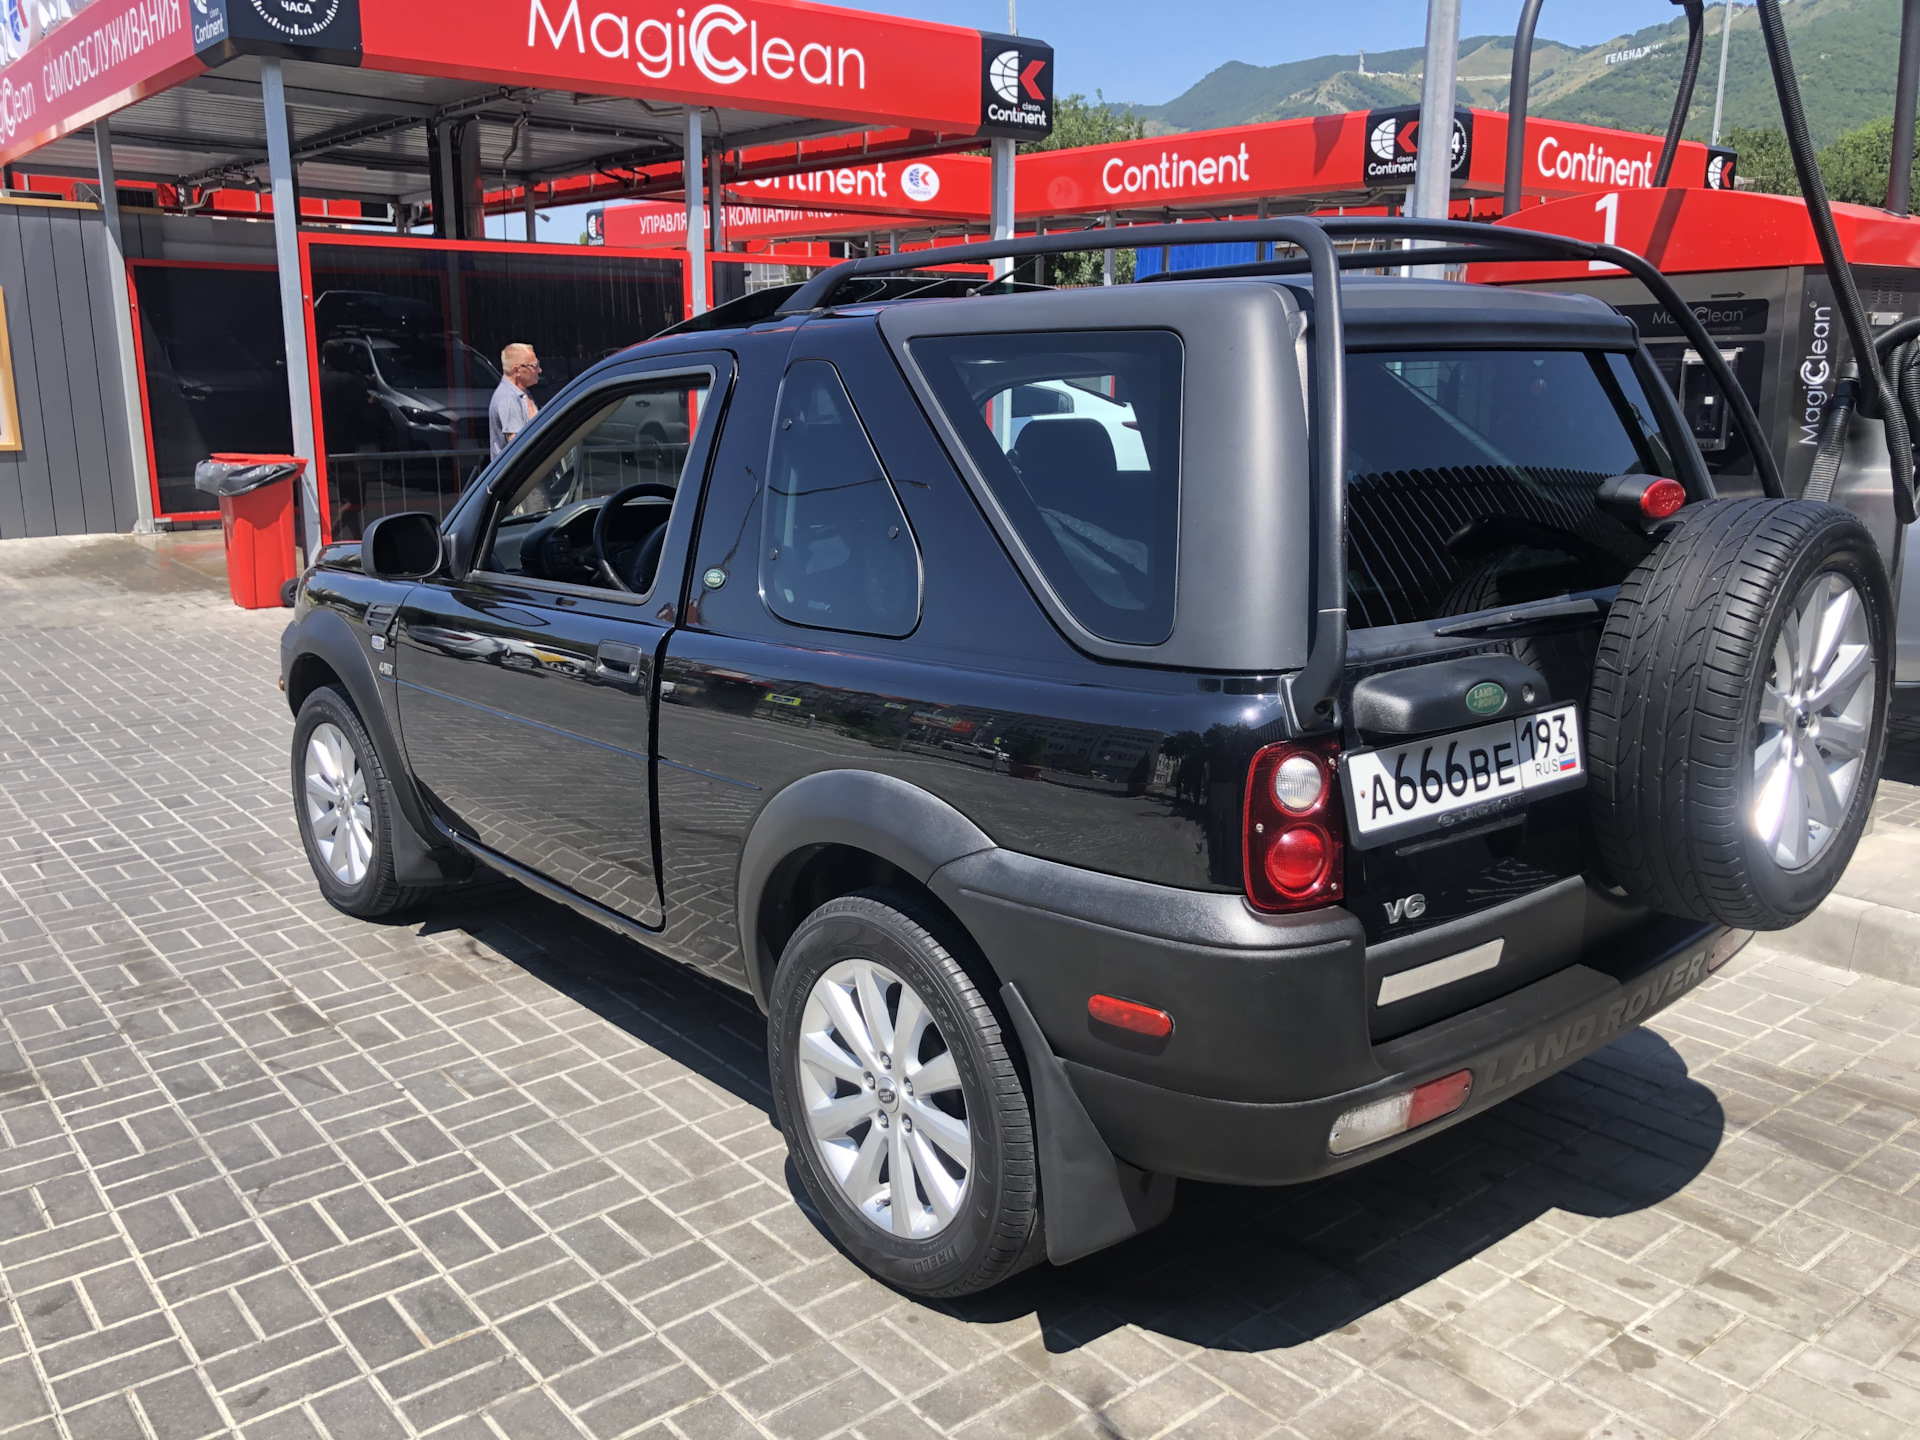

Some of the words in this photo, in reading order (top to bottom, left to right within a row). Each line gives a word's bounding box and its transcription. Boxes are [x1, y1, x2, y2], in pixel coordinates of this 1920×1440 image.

[281, 1, 313, 15] ЧАСА
[195, 13, 224, 44] Continent
[43, 0, 182, 103] САМООБСЛУЖИВАНИЯ
[527, 0, 866, 90] MagiClean
[988, 103, 1047, 126] Continent
[1022, 101, 1041, 111] clean
[1102, 142, 1250, 194] Continent
[1538, 136, 1653, 188] Continent
[1588, 193, 1618, 271] 1
[1652, 307, 1743, 325] MaClean
[1474, 687, 1493, 699] LAND
[1520, 714, 1568, 762] 193
[1535, 758, 1559, 777] RUS
[1383, 893, 1426, 924] V6
[1480, 1014, 1597, 1096] LAND
[1600, 950, 1706, 1037] ROVER
